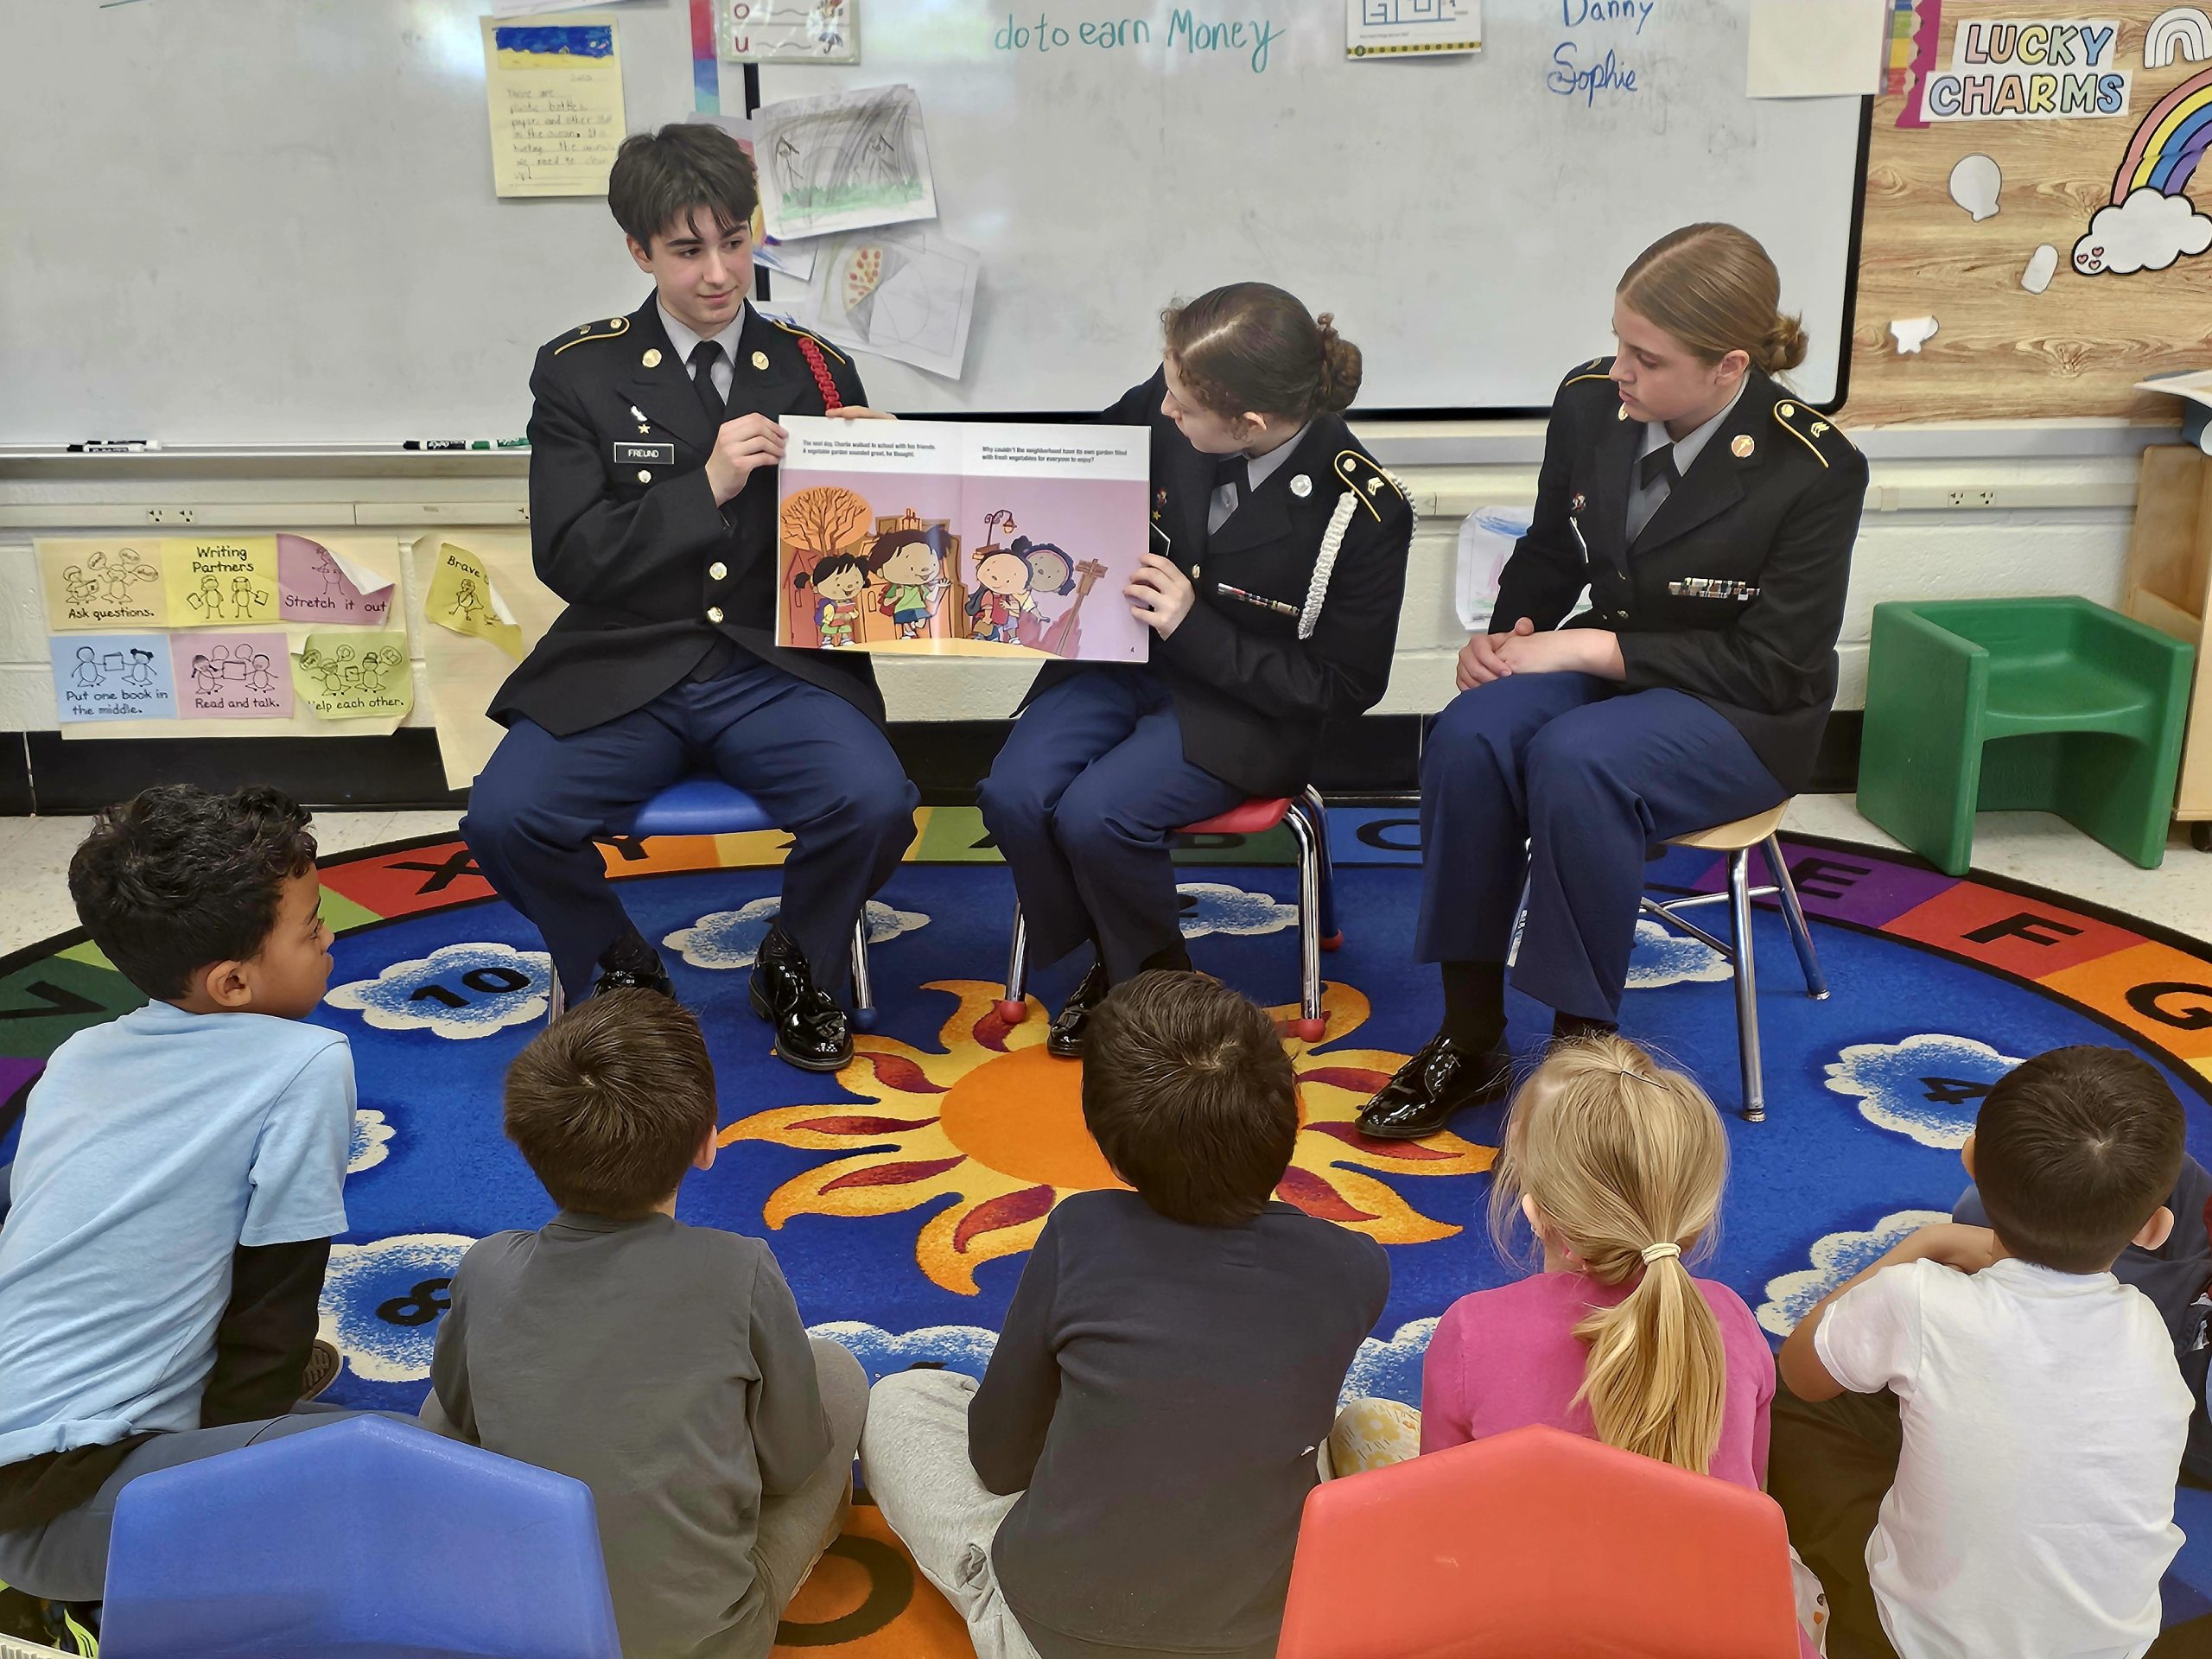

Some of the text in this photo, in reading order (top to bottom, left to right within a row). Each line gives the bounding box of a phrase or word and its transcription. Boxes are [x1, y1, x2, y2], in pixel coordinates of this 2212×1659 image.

[1563, 0, 1654, 35] Danny
[1079, 18, 1150, 48] earn
[1167, 9, 1286, 74] Money
[1965, 24, 2113, 67] LUCKY
[1547, 41, 1637, 108] Sophie
[1929, 73, 2125, 117] CHARMS
[628, 449, 659, 458] FREUND
[193, 562, 254, 573] Partners
[196, 546, 247, 561] Writing
[447, 556, 480, 578] Brave
[69, 607, 155, 621] Ask questions.
[285, 595, 386, 612] Stretch it out
[67, 690, 168, 701] Put one book in
[73, 703, 143, 715] the middle.
[195, 697, 281, 709] Read and talk.
[308, 696, 404, 713] elp each other.
[382, 849, 482, 895] X
[1792, 858, 1872, 899] E
[1961, 912, 2085, 947] F
[408, 965, 531, 1008] 10
[2125, 981, 2212, 1031] G
[1918, 1076, 1993, 1106] 4
